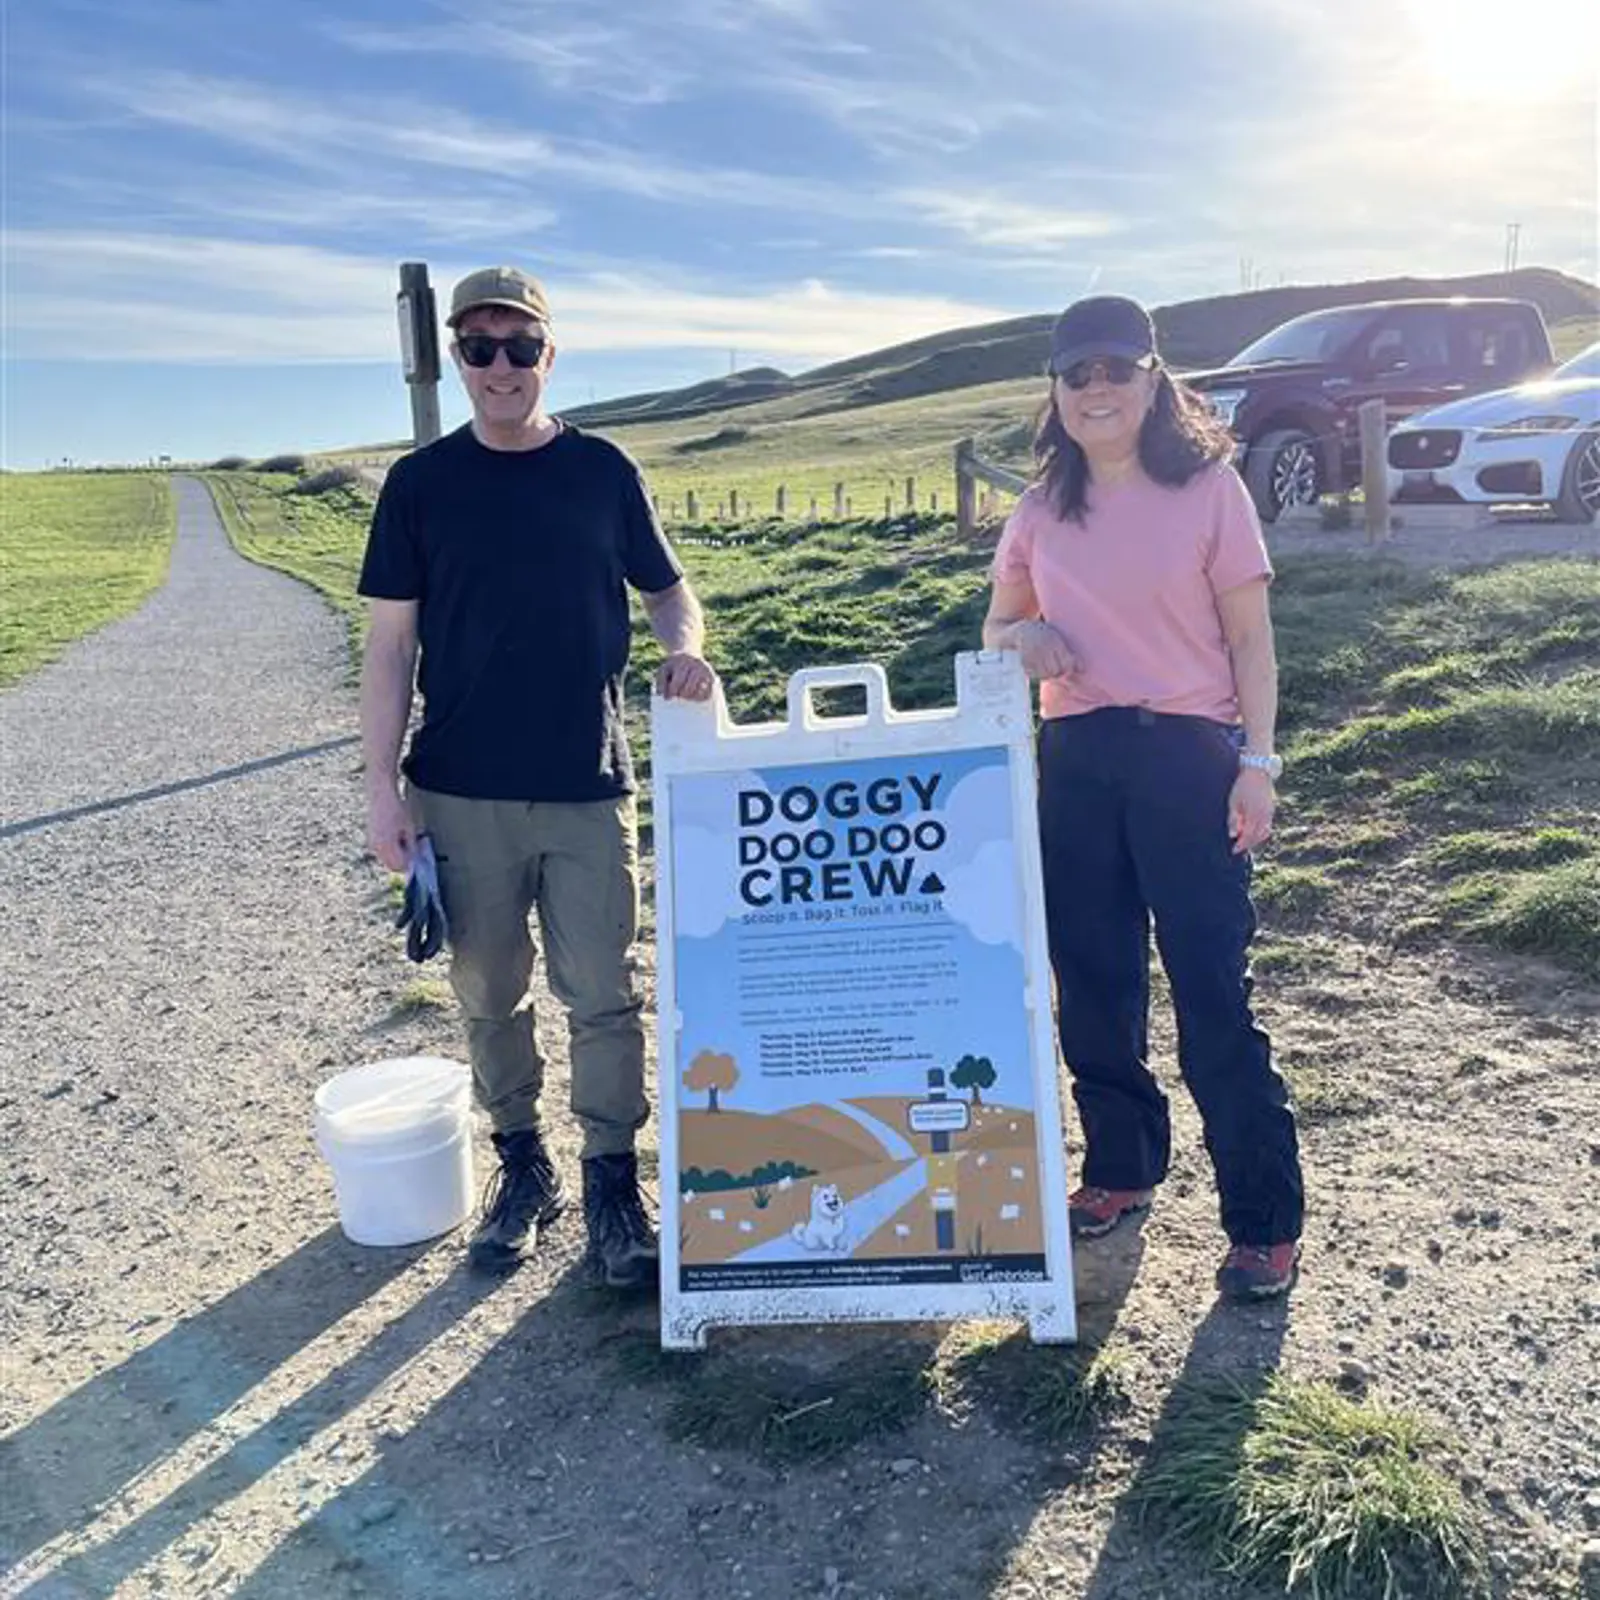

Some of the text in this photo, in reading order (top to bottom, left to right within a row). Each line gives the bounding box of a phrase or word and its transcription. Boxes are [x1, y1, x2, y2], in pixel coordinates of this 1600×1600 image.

[738, 772, 942, 828] DOGGY
[738, 820, 947, 866] DOO DOO
[740, 856, 915, 907] CREW
